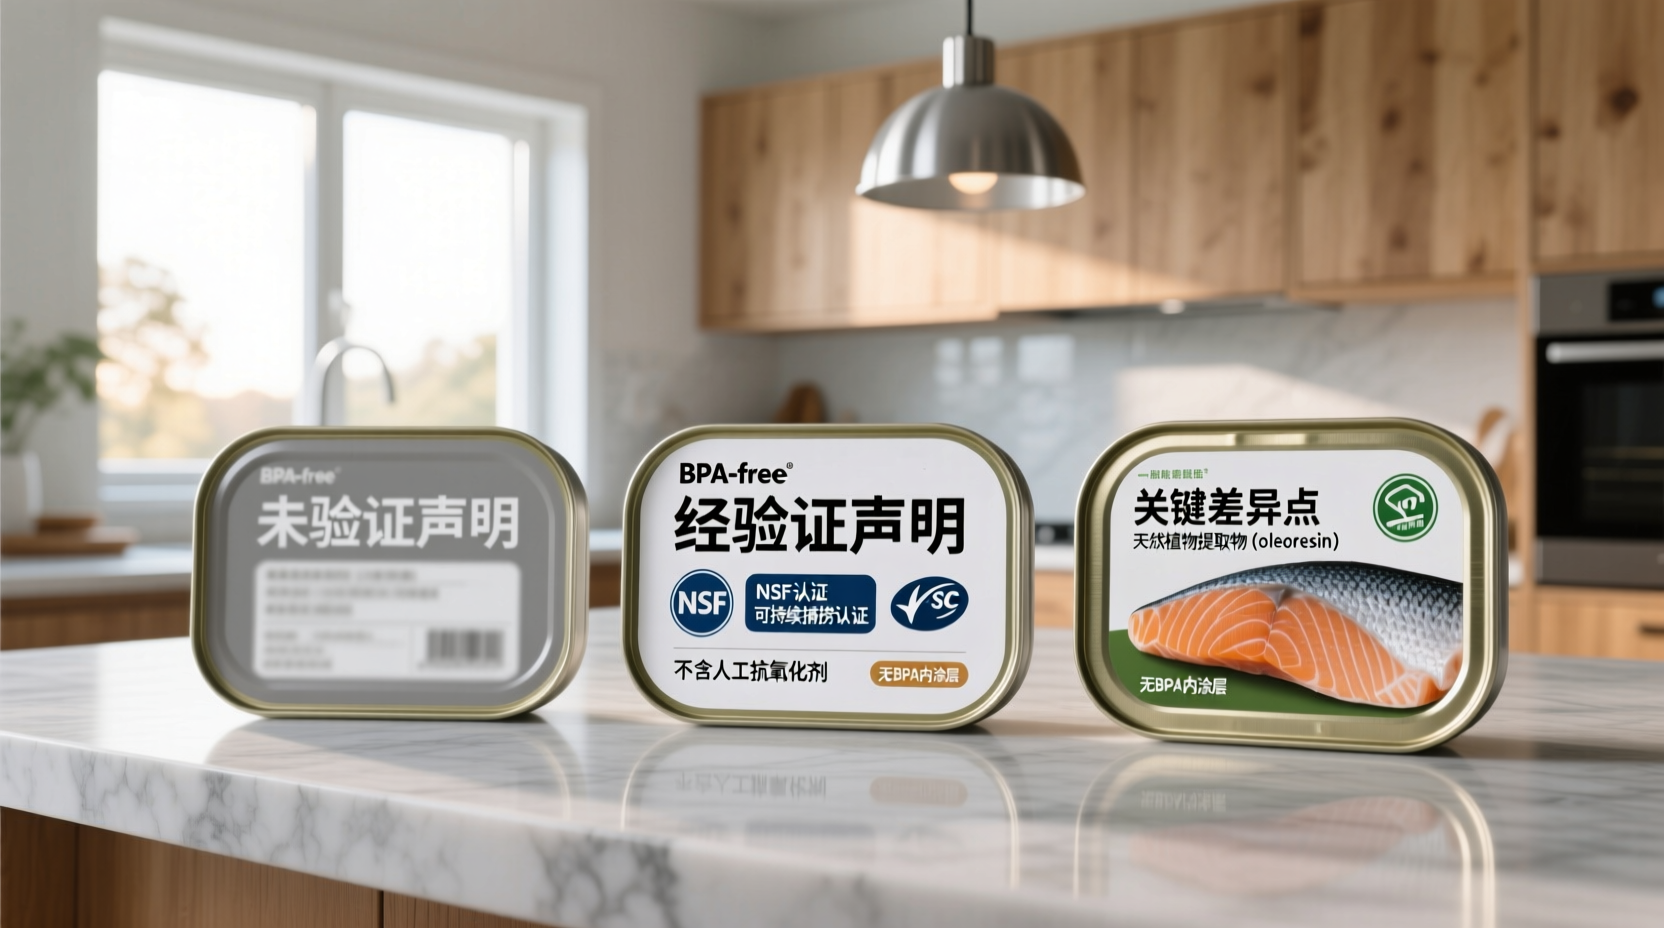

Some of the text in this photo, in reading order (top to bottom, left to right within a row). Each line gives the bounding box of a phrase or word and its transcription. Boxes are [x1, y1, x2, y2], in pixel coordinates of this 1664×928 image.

[257, 495, 519, 549] 未验证声明
[674, 495, 965, 555] 经验证声明
[1134, 487, 1320, 526] 关键差异点
[1252, 532, 1339, 551] (oleoresin)
[678, 590, 727, 615] NSF
